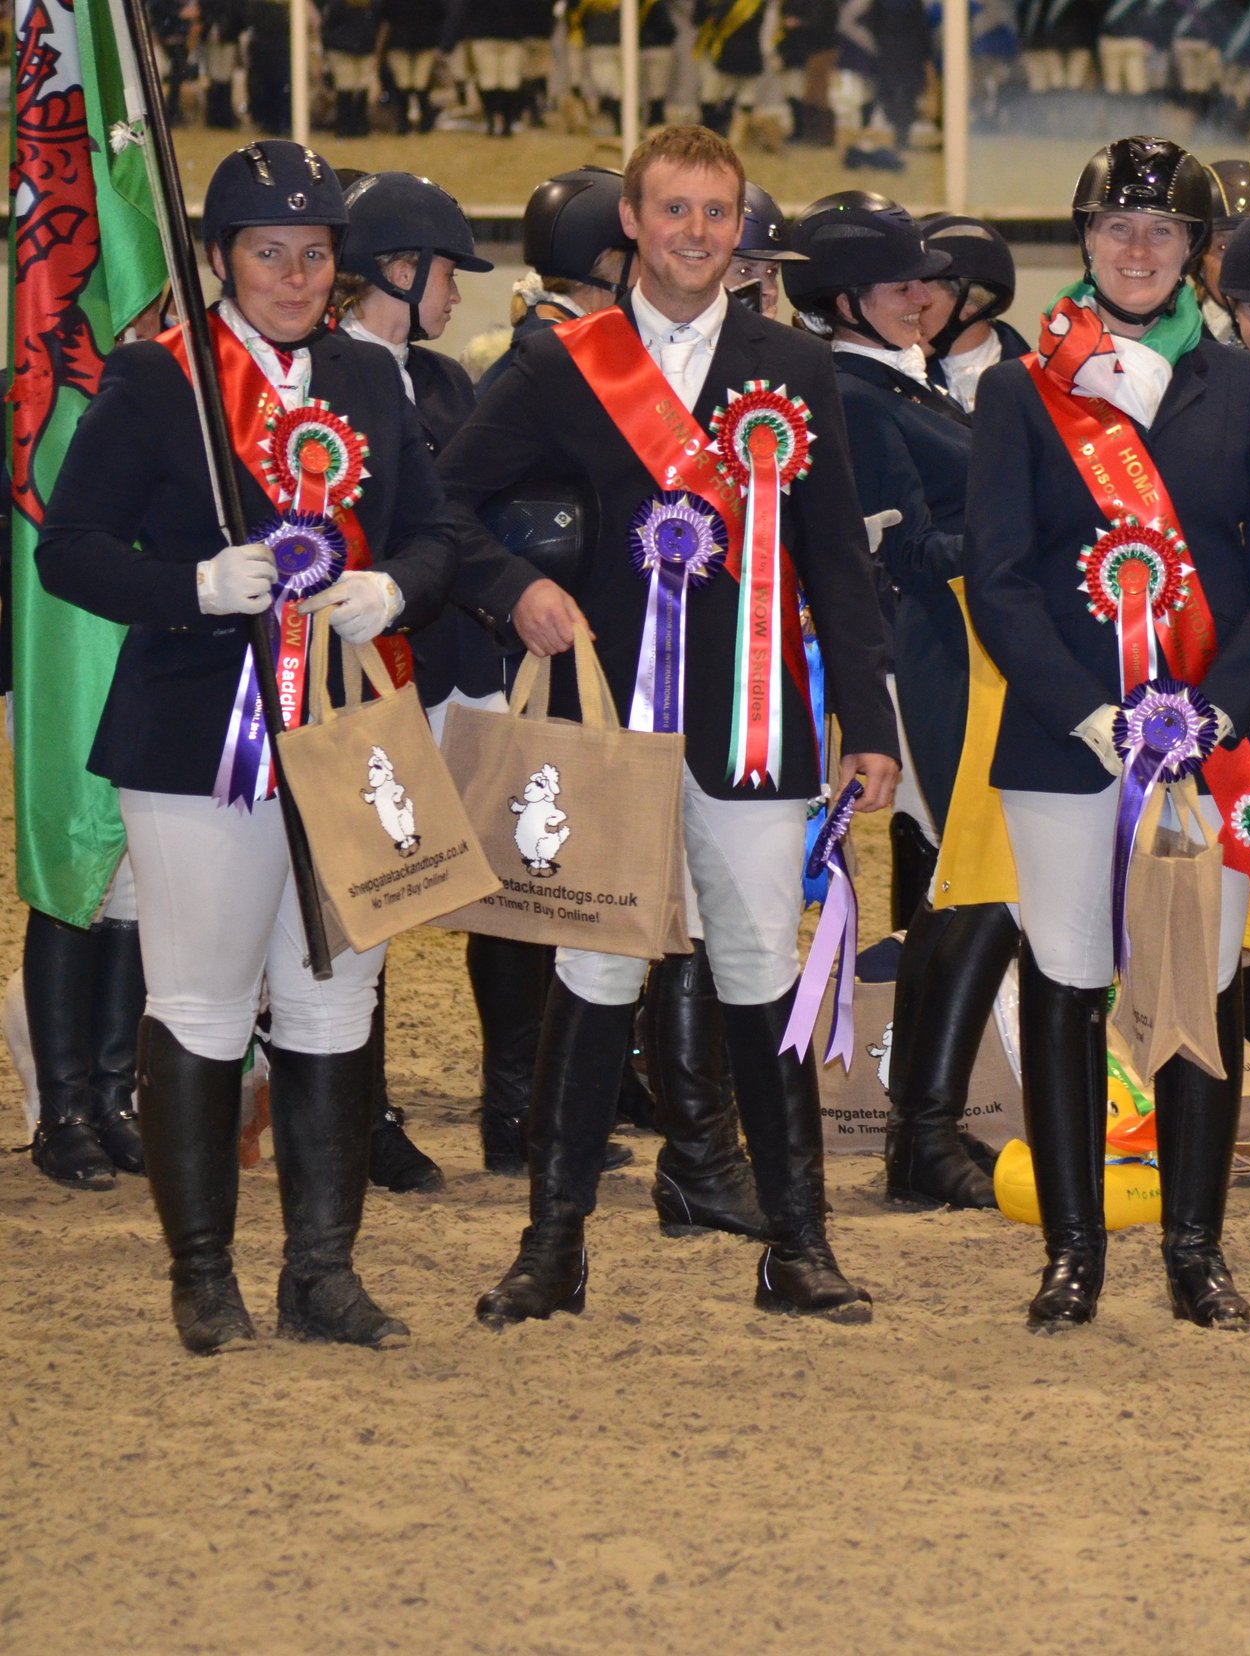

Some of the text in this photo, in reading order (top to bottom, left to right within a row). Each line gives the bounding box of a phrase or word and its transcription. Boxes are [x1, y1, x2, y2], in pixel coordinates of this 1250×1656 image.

[655, 399, 711, 470] SENIOR
[1118, 447, 1160, 507] HOME
[663, 653, 672, 709] INTERNATIONAL
[752, 586, 768, 722] WOW Saddles
[279, 657, 300, 728] Saddle
[370, 869, 449, 910] No Time? Buy Online!
[496, 895, 529, 912] Time?
[533, 902, 554, 918] Buy
[557, 907, 600, 923] Online!
[498, 876, 638, 907] etackandtogs.co.uk
[838, 1124, 887, 1134] No Time
